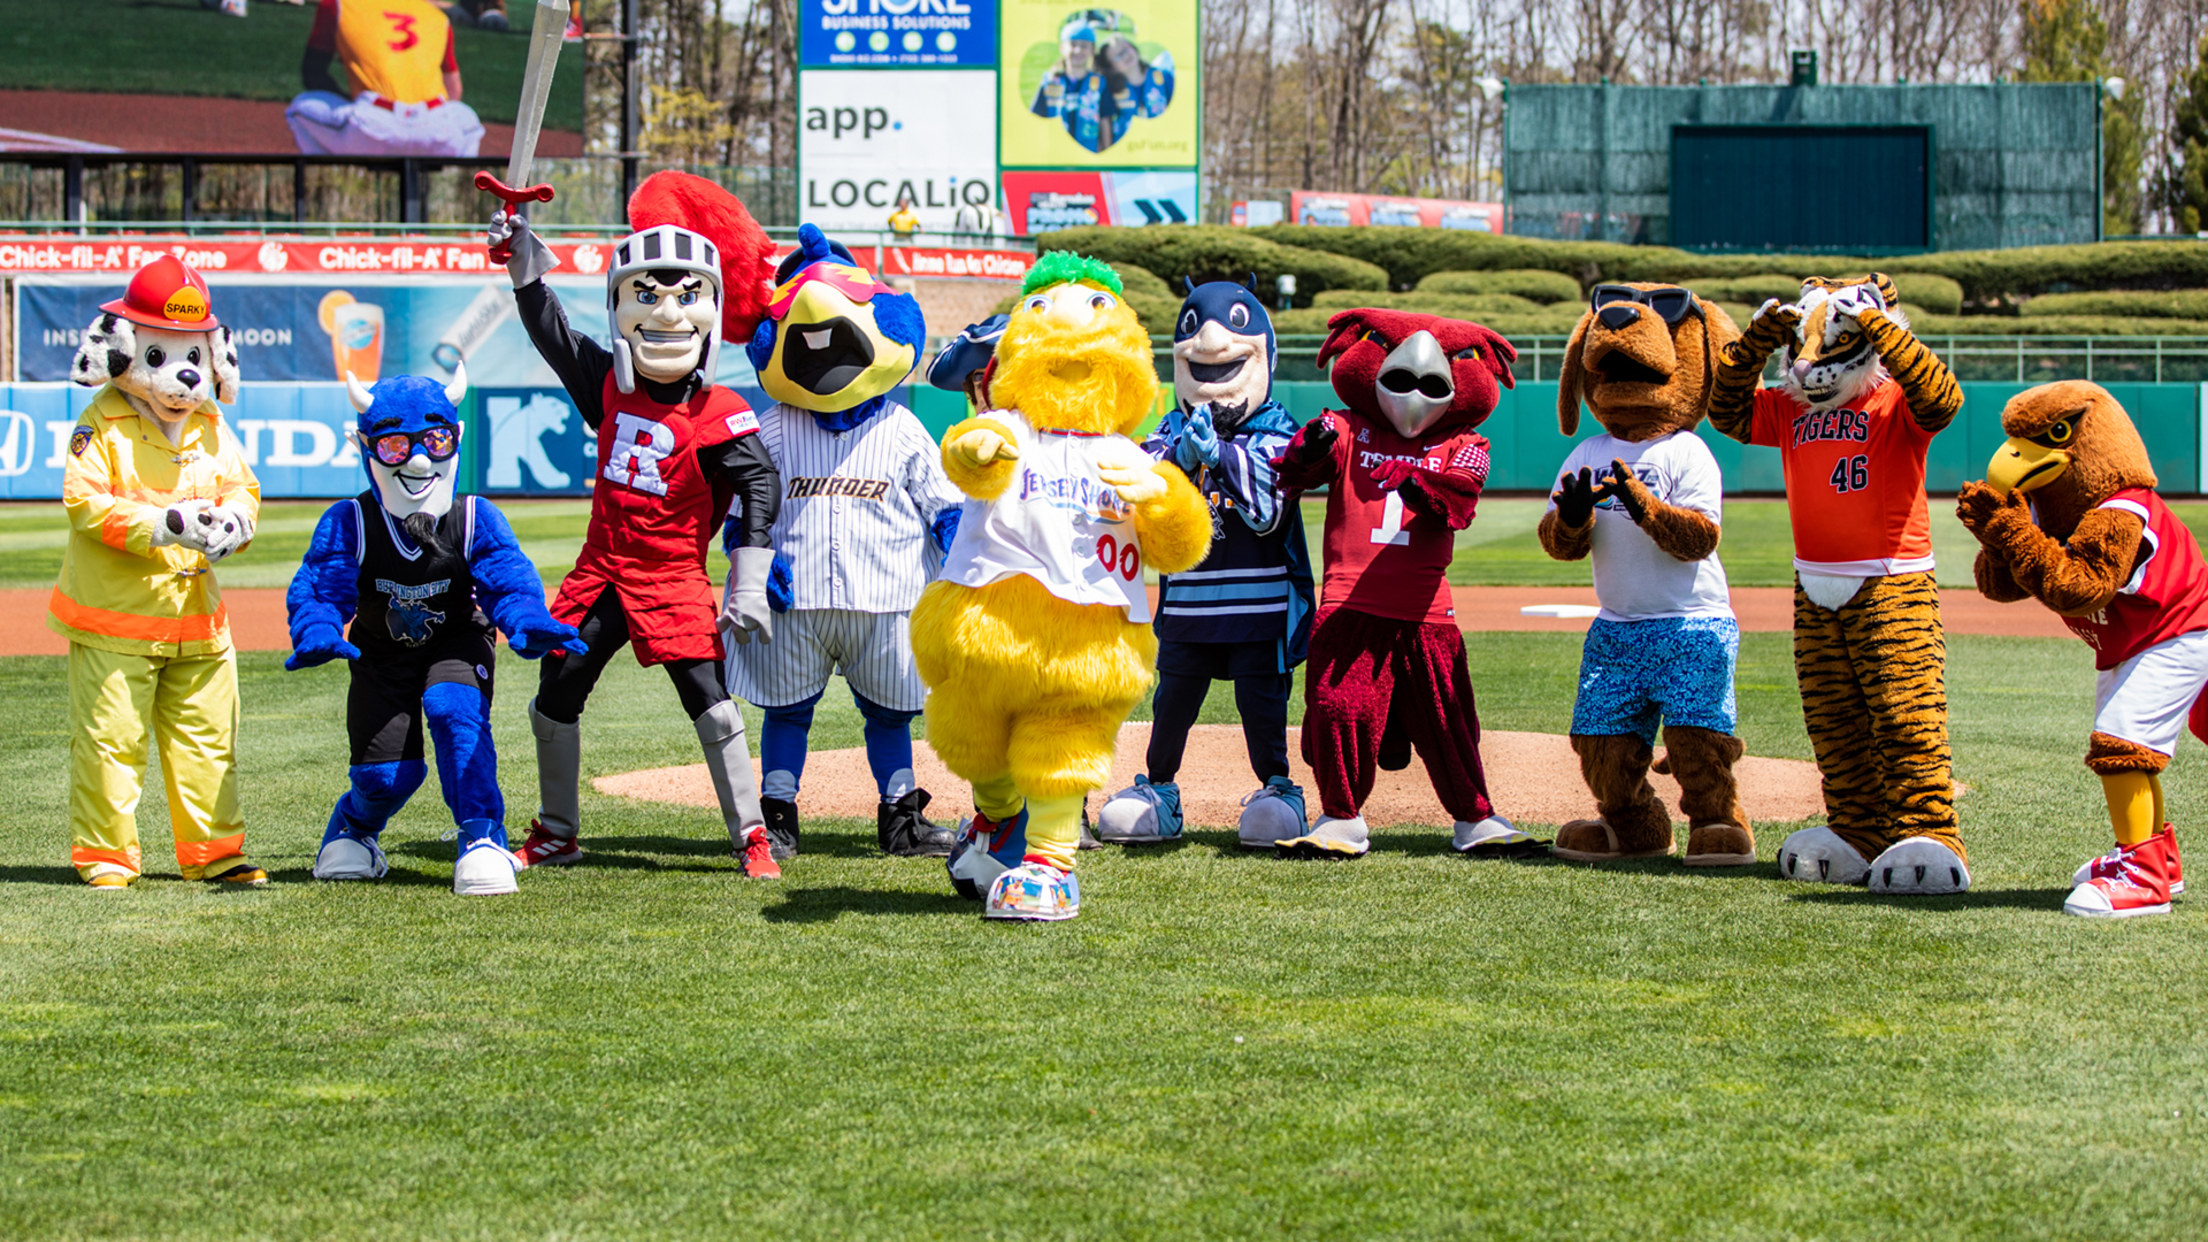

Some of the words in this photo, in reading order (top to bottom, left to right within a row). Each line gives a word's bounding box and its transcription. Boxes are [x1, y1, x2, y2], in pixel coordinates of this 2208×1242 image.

[383, 10, 419, 51] 3
[821, 15, 889, 30] BUSINESS
[892, 15, 971, 30] SOLUTIONS
[446, 247, 485, 269] Fan
[166, 303, 205, 314] SPARKY
[1791, 409, 1869, 449] TIGERS
[602, 411, 676, 497] R
[1829, 454, 1869, 494] 46
[786, 475, 890, 502] THUNDER
[1096, 534, 1139, 582] 00
